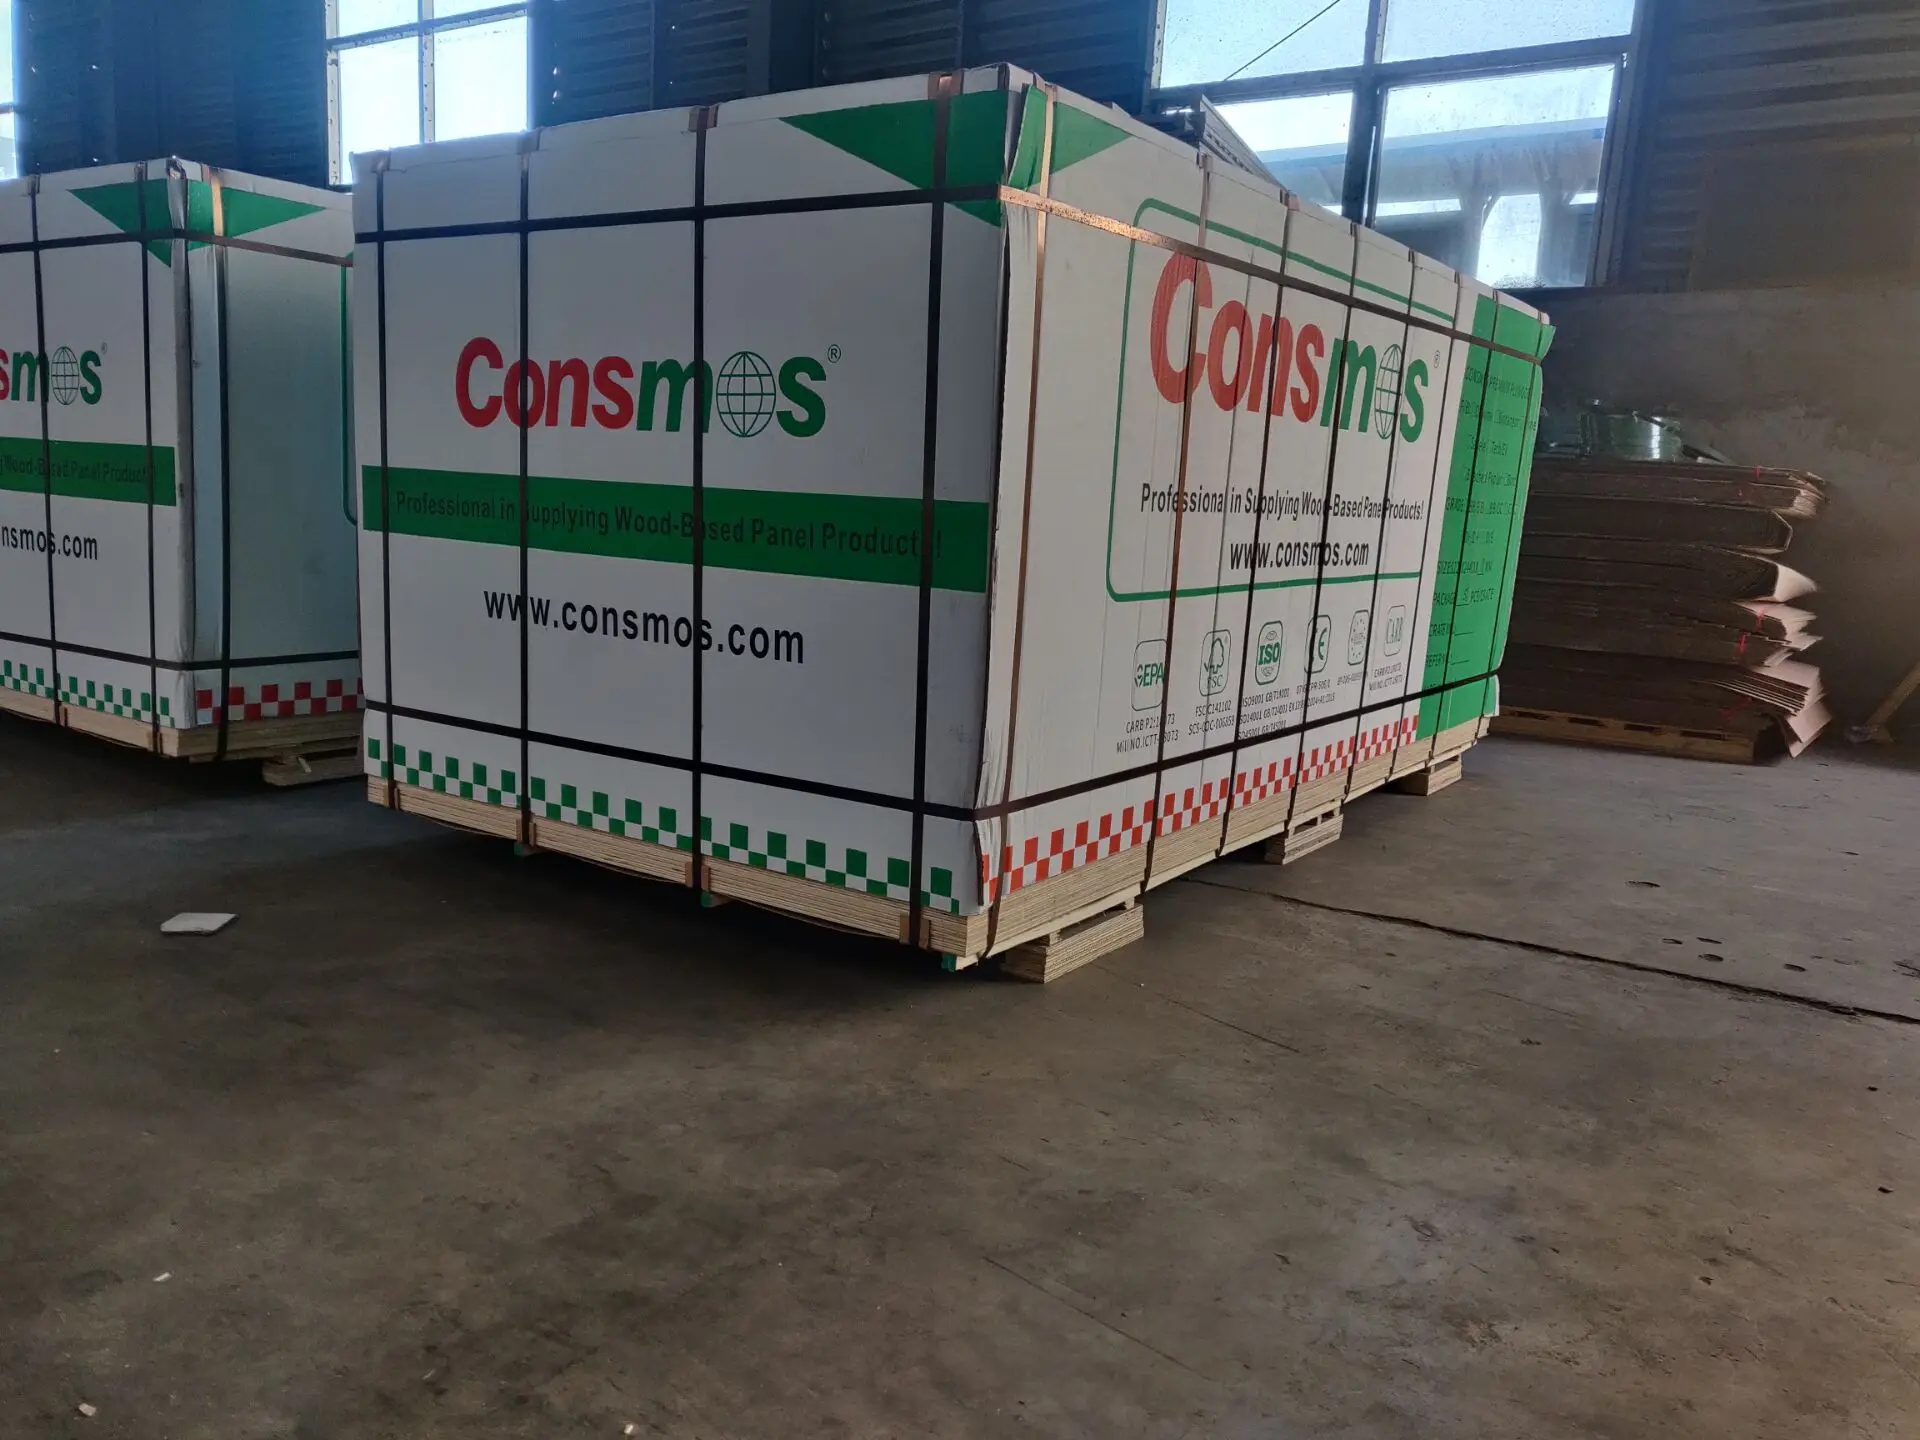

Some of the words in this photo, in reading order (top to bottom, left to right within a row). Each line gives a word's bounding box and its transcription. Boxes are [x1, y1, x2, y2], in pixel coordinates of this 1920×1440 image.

[1141, 482, 1226, 513] Professiona
[1229, 487, 1242, 514] in
[1301, 491, 1363, 518] Woo-Based
[1363, 496, 1382, 519] Pane
[396, 490, 495, 519] Professional
[499, 497, 515, 520] in
[523, 501, 609, 535] upplying
[751, 518, 814, 550] Panel
[822, 522, 941, 558] Product!
[1230, 541, 1369, 570] www.consmos.com
[484, 590, 804, 664] www.consmos.com
[1258, 642, 1280, 665] ISO
